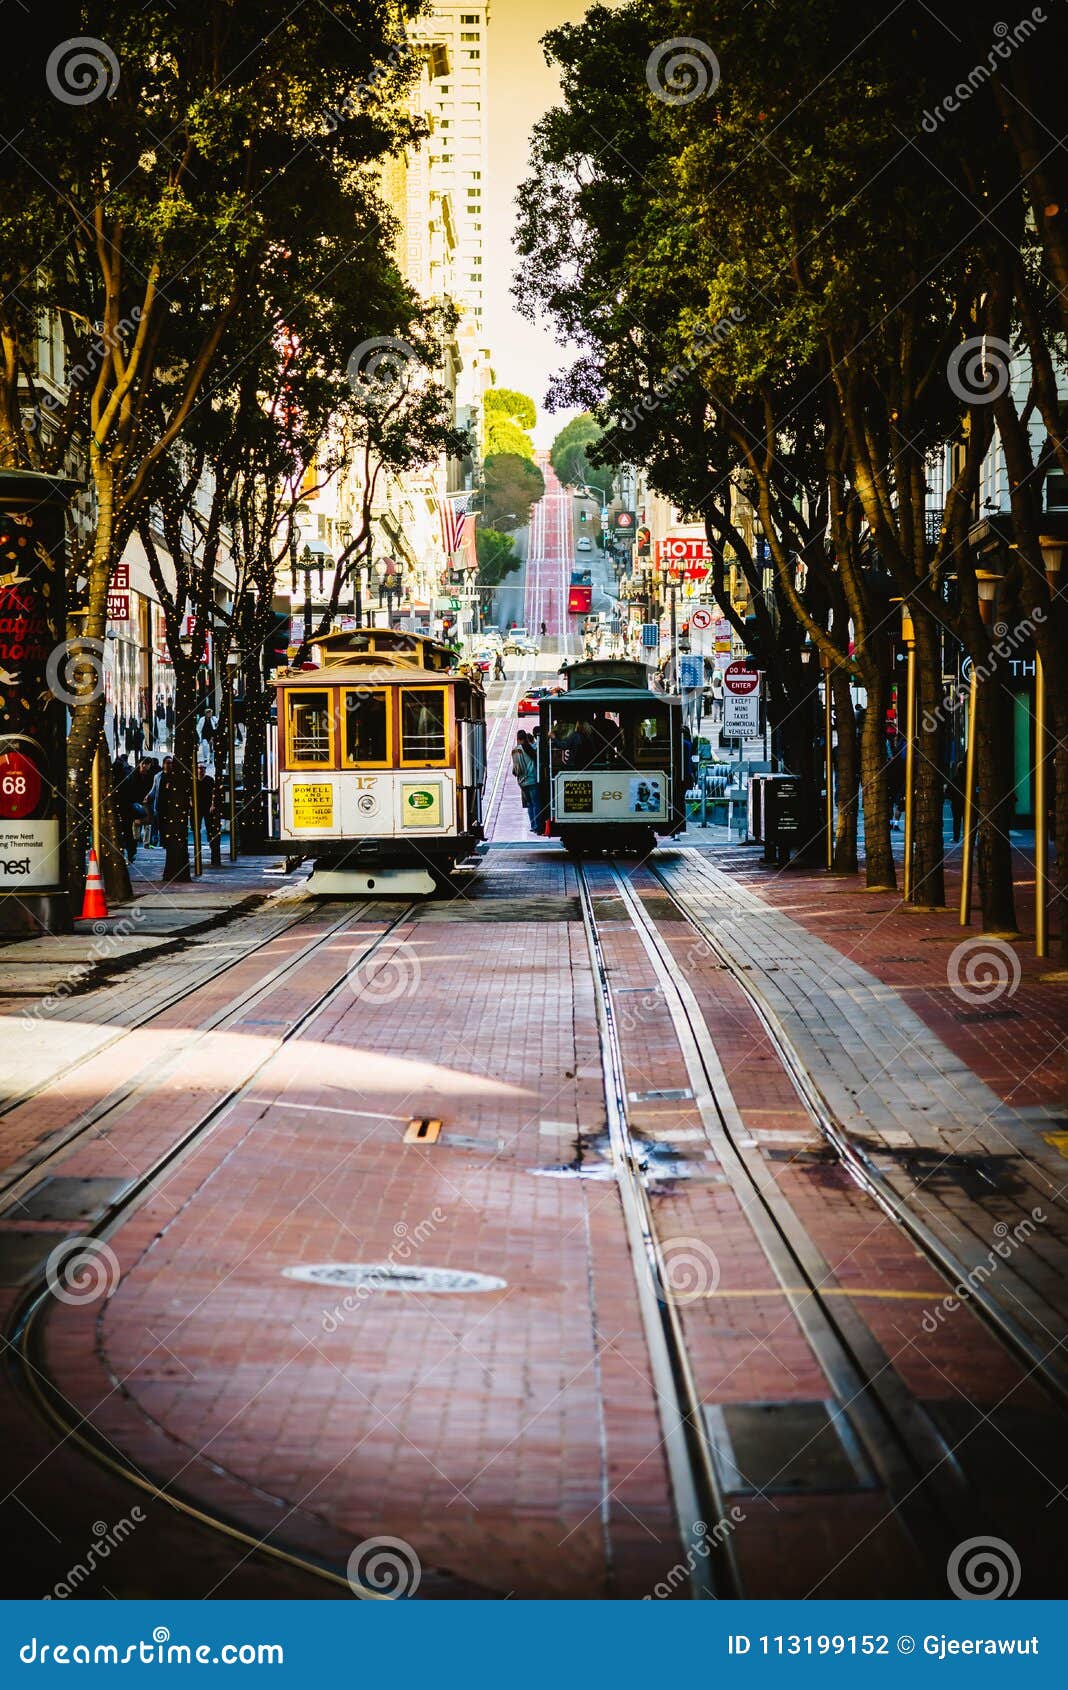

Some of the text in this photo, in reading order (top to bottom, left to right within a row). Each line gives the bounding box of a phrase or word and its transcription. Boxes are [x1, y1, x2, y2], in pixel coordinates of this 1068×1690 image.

[659, 541, 713, 557] HOTE
[107, 597, 125, 607] UNI
[2, 777, 26, 794] 68
[355, 777, 378, 789] 17
[600, 791, 623, 800] 26
